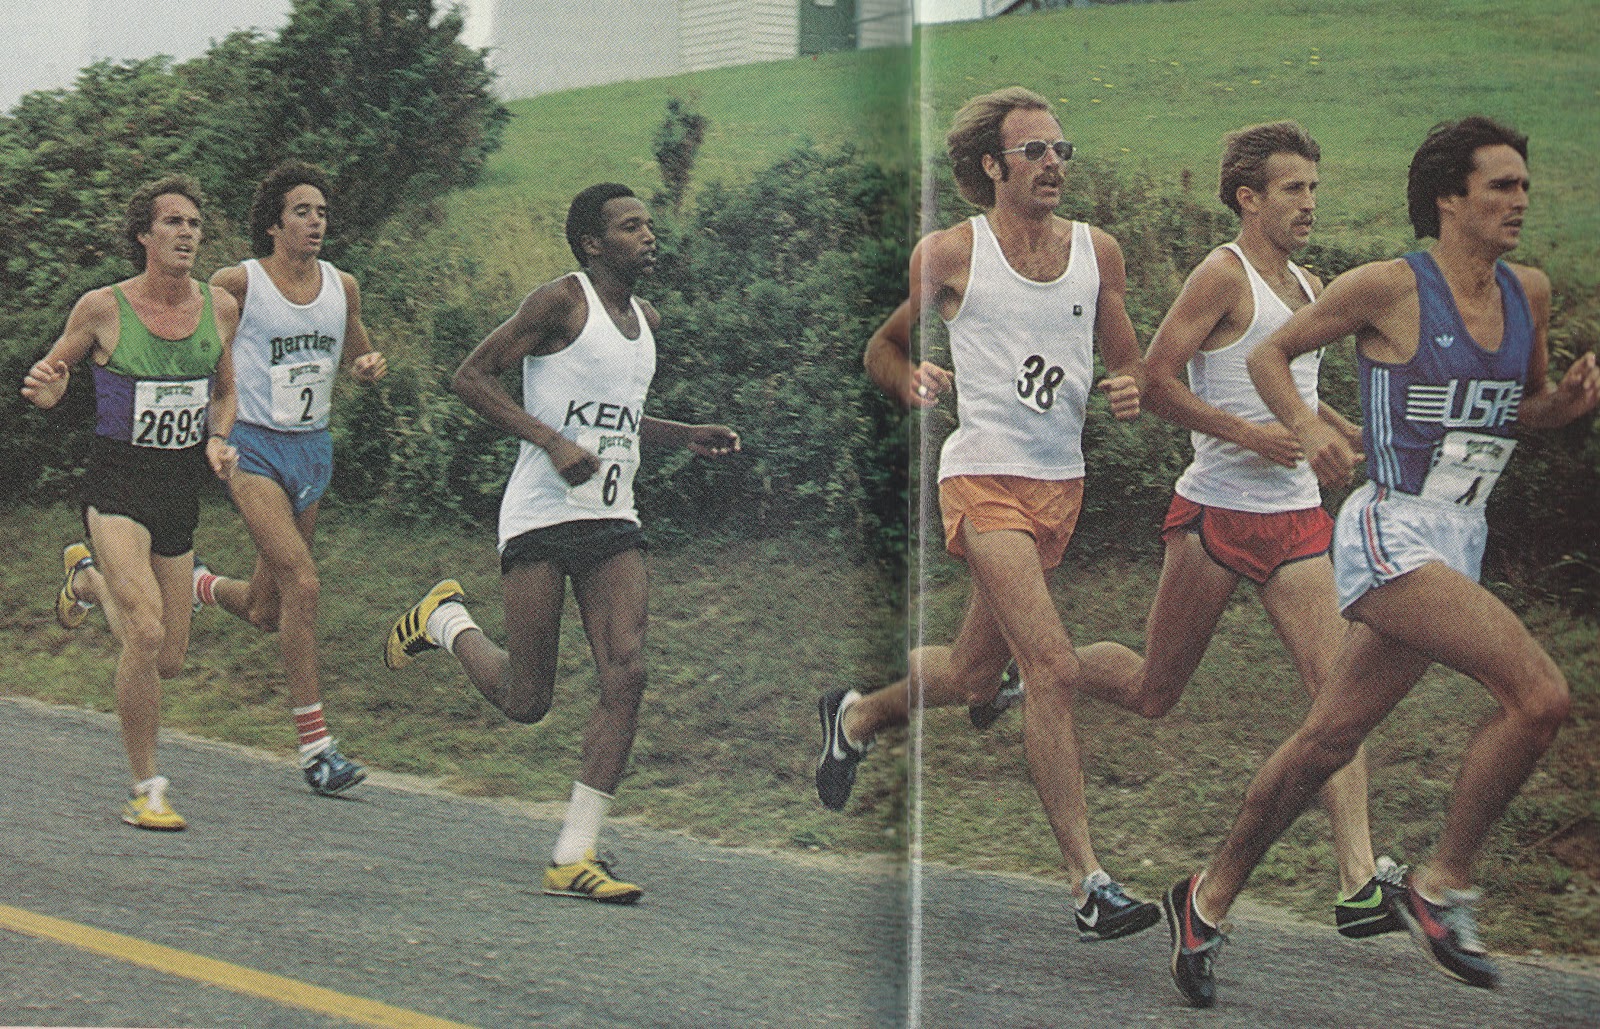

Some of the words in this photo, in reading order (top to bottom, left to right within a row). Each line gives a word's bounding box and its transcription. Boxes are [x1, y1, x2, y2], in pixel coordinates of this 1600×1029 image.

[300, 387, 313, 421] 2
[1017, 354, 1065, 410] 38
[1442, 379, 1517, 428] USA
[603, 463, 620, 506] 6
